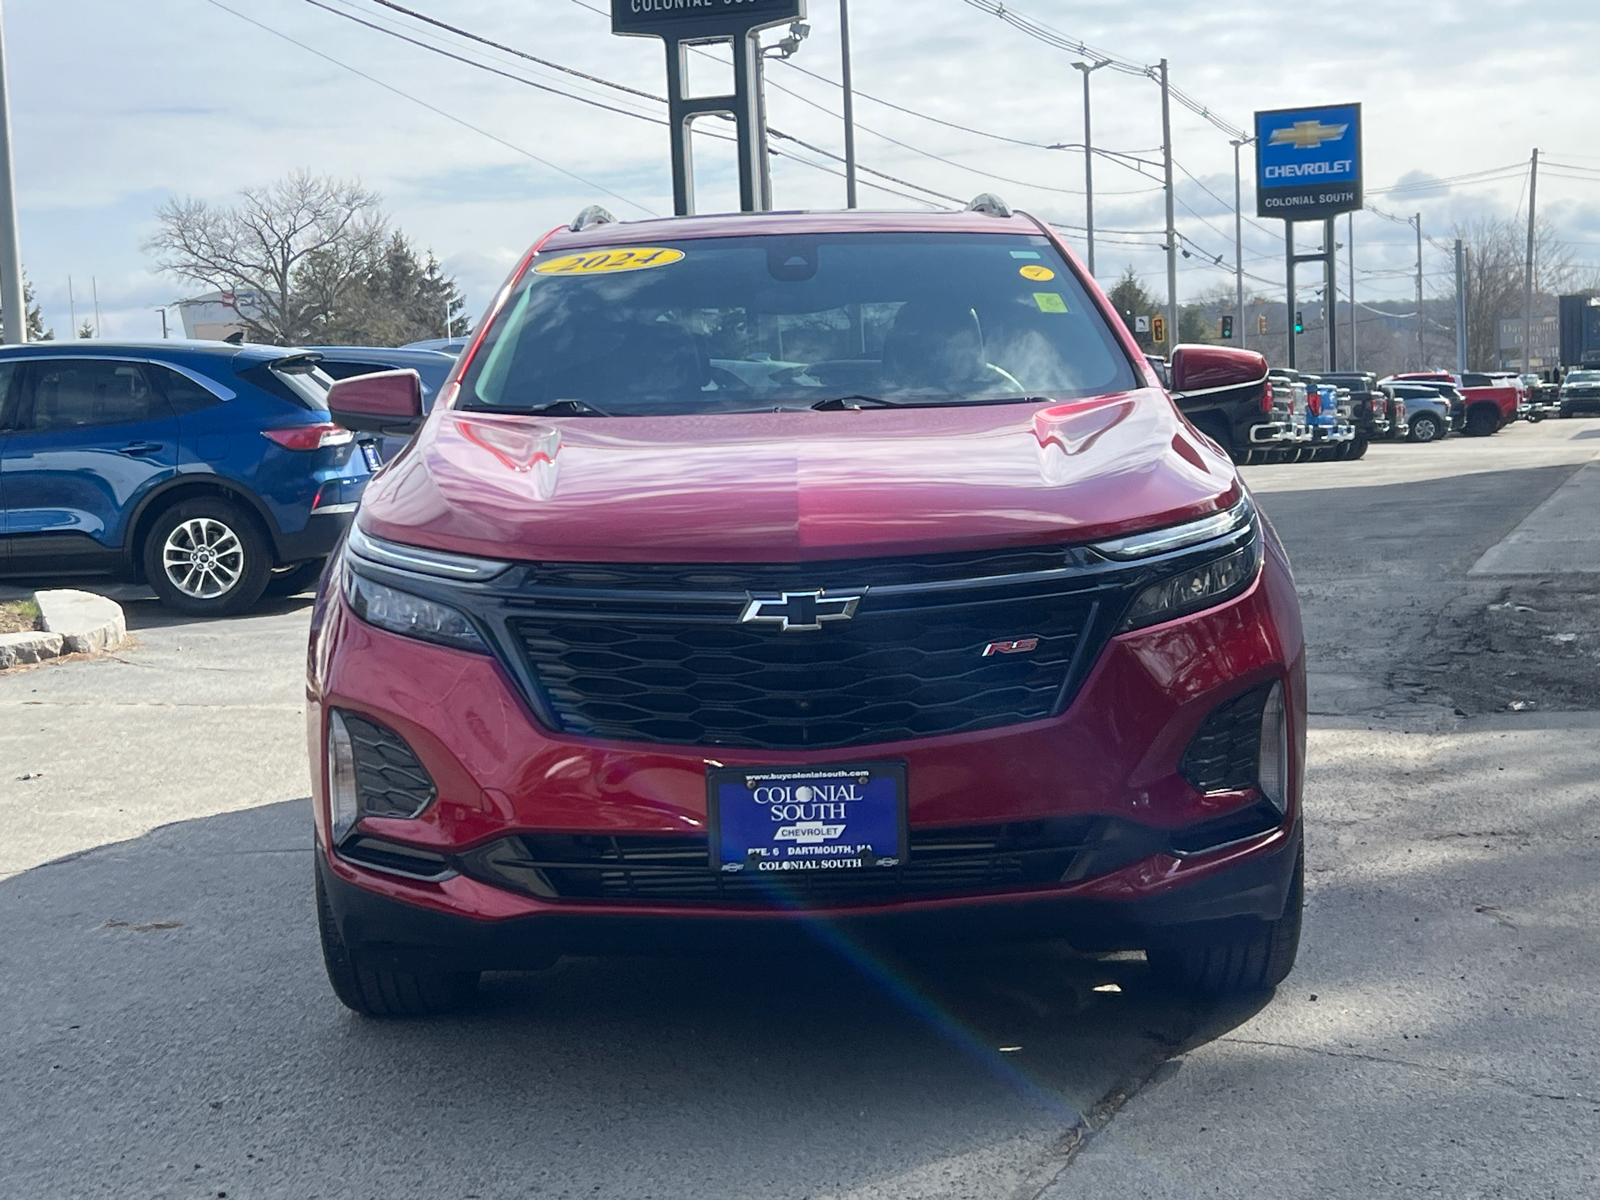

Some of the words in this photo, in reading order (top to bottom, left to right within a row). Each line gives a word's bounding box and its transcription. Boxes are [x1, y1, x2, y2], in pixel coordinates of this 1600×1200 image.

[1265, 160, 1352, 178] CHEVROLET
[1265, 195, 1316, 208] COLONIAL
[1319, 192, 1354, 204] SOUTH
[549, 250, 667, 272] 2024
[1503, 321, 1559, 334] Darmouth
[1514, 332, 1548, 344] Dntal
[982, 637, 1039, 657] RS
[745, 770, 869, 780] www.buycolonialsouth.com
[753, 784, 864, 804] COLONIAL
[771, 803, 847, 821] SOUTH
[781, 827, 838, 837] CHEVROLET
[773, 847, 780, 856] 6
[787, 845, 855, 856] DARTMOUTH,
[759, 860, 819, 871] COLONIAL
[821, 858, 862, 869] SOUTH
